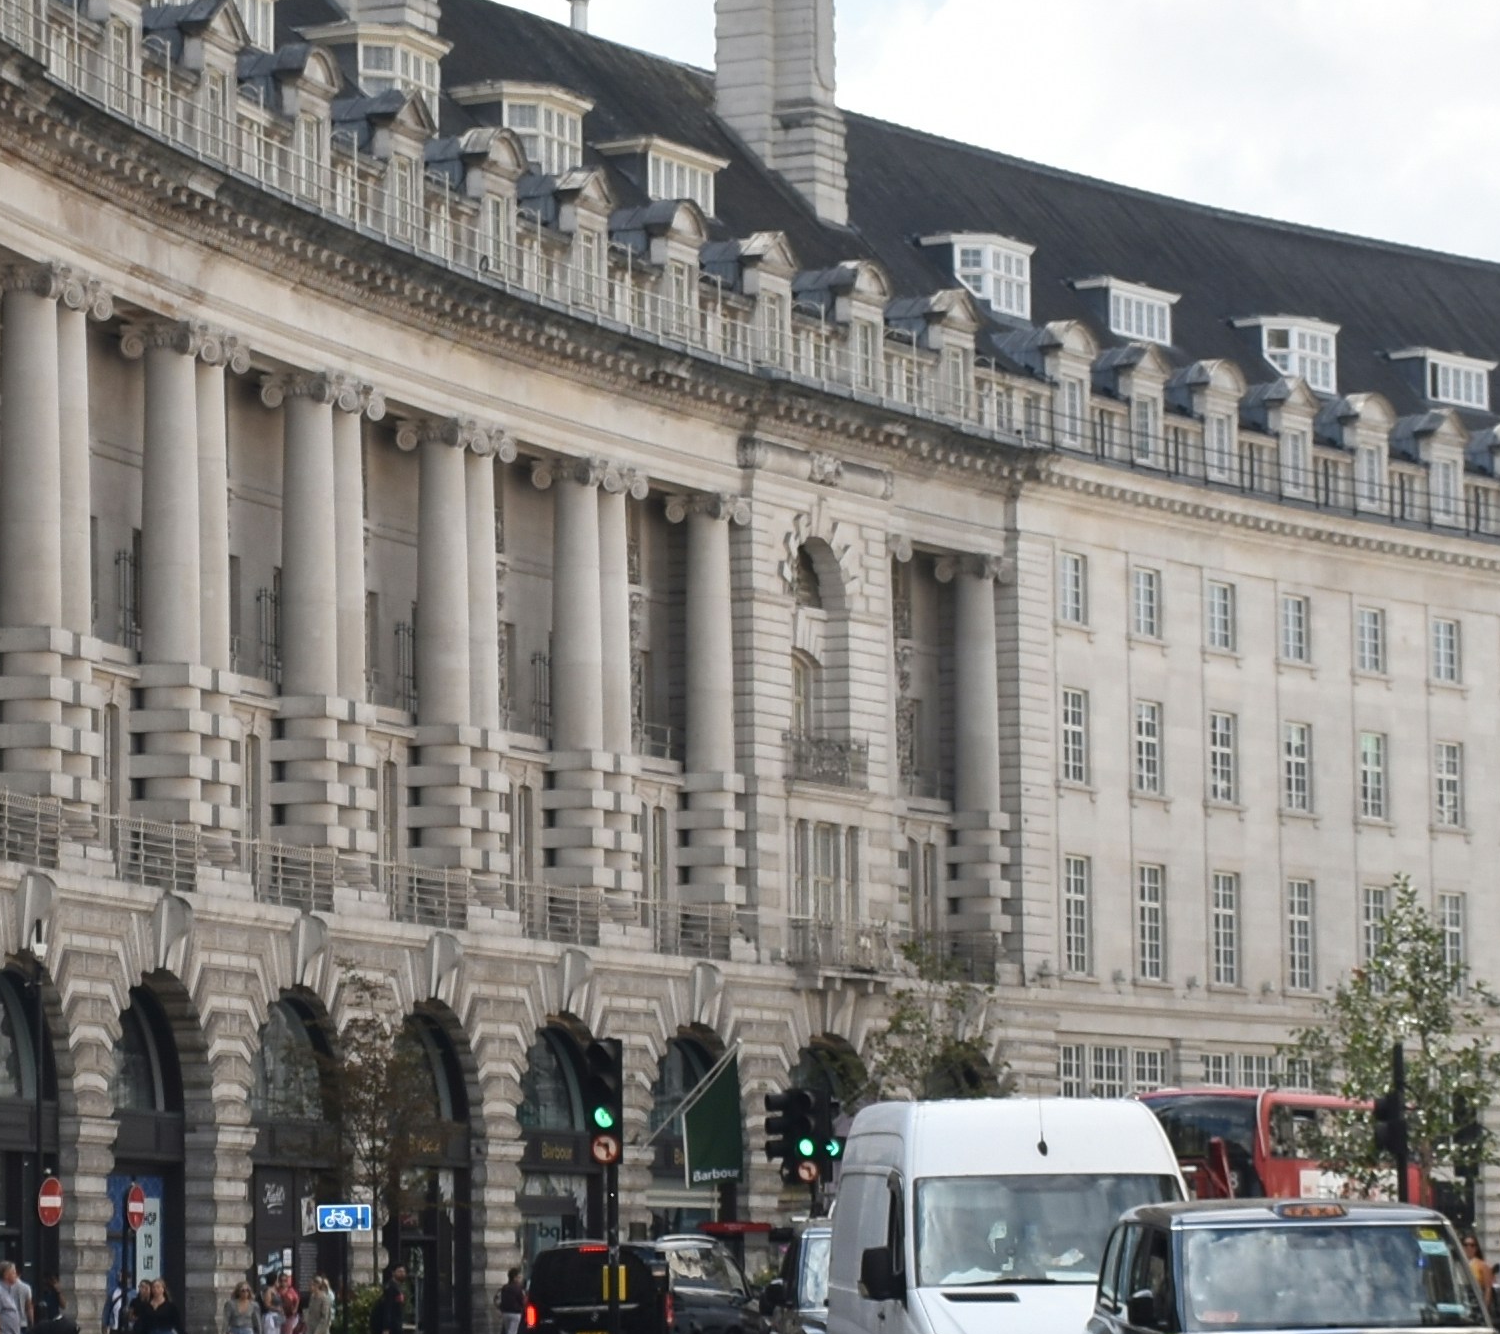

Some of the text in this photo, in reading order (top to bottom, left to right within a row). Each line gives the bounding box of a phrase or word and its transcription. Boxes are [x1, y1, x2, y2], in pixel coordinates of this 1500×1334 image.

[541, 1140, 574, 1161] Barbour
[692, 1168, 740, 1183] Barbour
[144, 1234, 153, 1248] TO
[143, 1255, 154, 1270] LET
